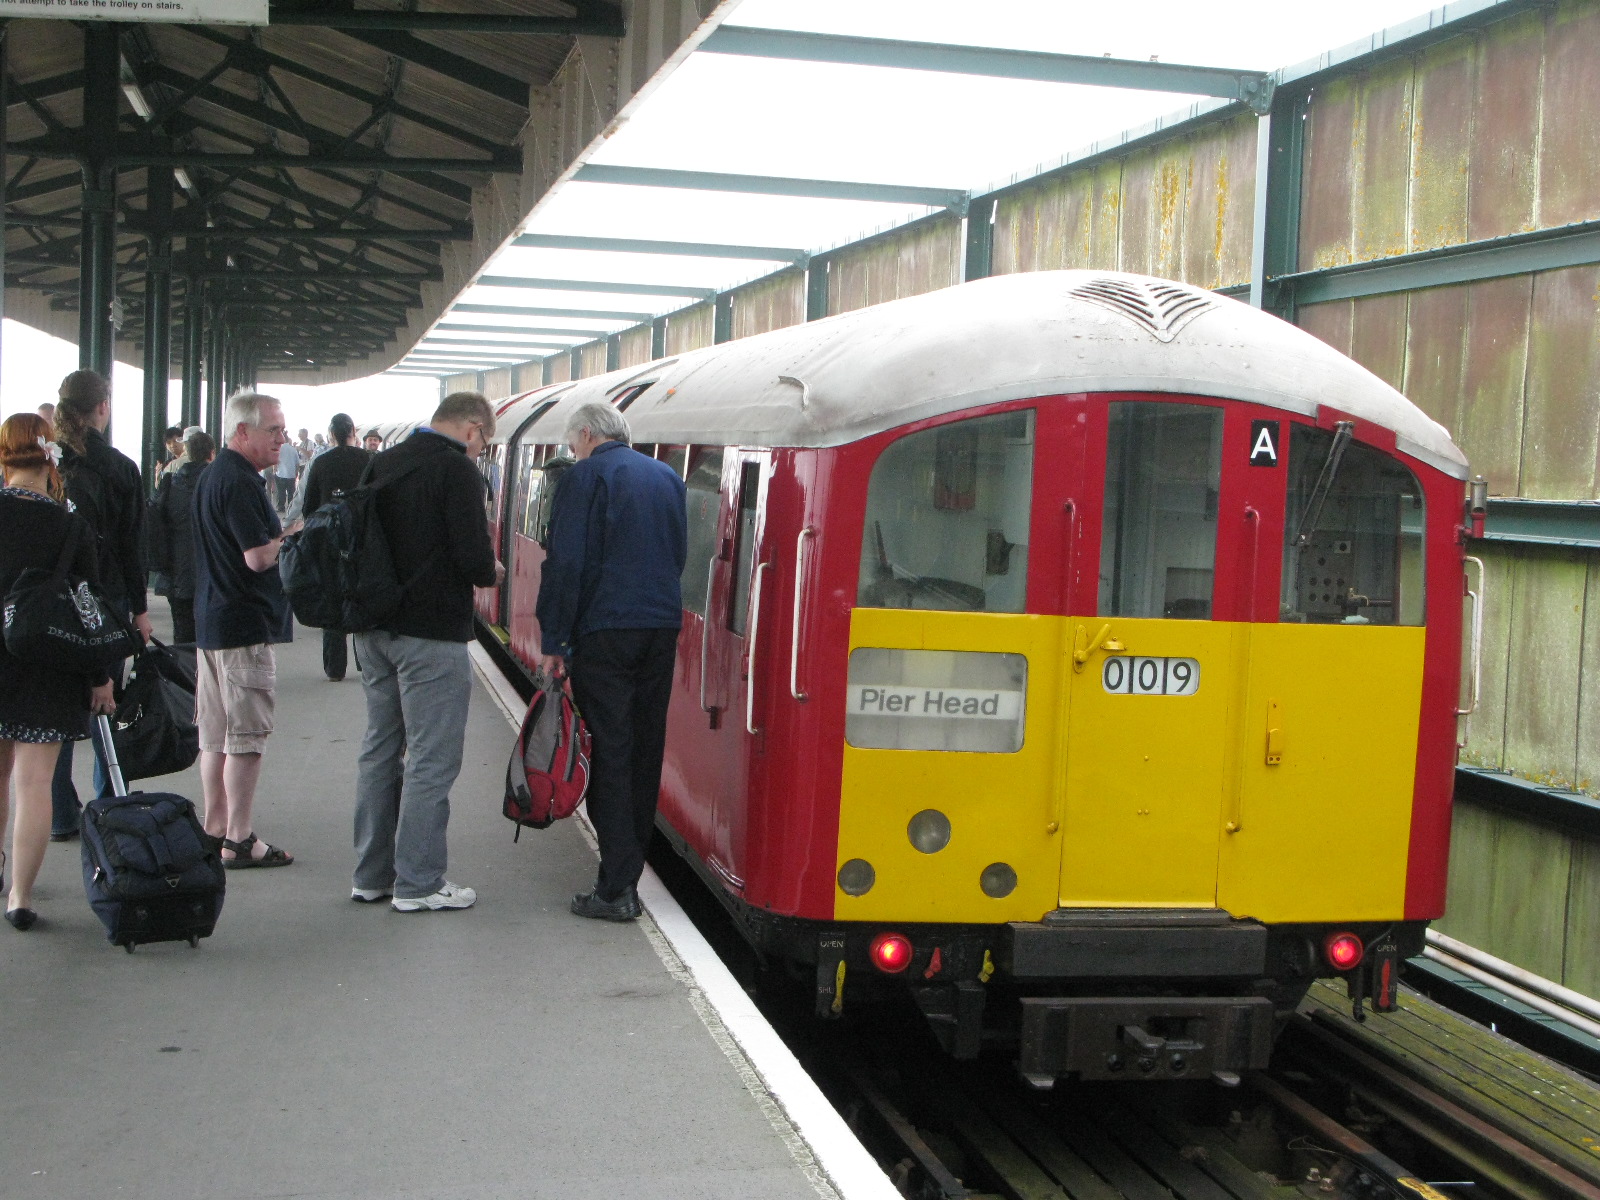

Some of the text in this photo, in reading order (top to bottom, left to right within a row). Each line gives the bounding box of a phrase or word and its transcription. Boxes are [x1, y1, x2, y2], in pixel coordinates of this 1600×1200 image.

[110, 0, 138, 10] trolley
[156, 1, 184, 10] stairs.
[1250, 428, 1277, 460] A
[47, 626, 86, 646] DEATH
[860, 688, 1000, 716] Pier Head
[819, 940, 844, 948] OPEN
[1376, 944, 1397, 952] OPEN
